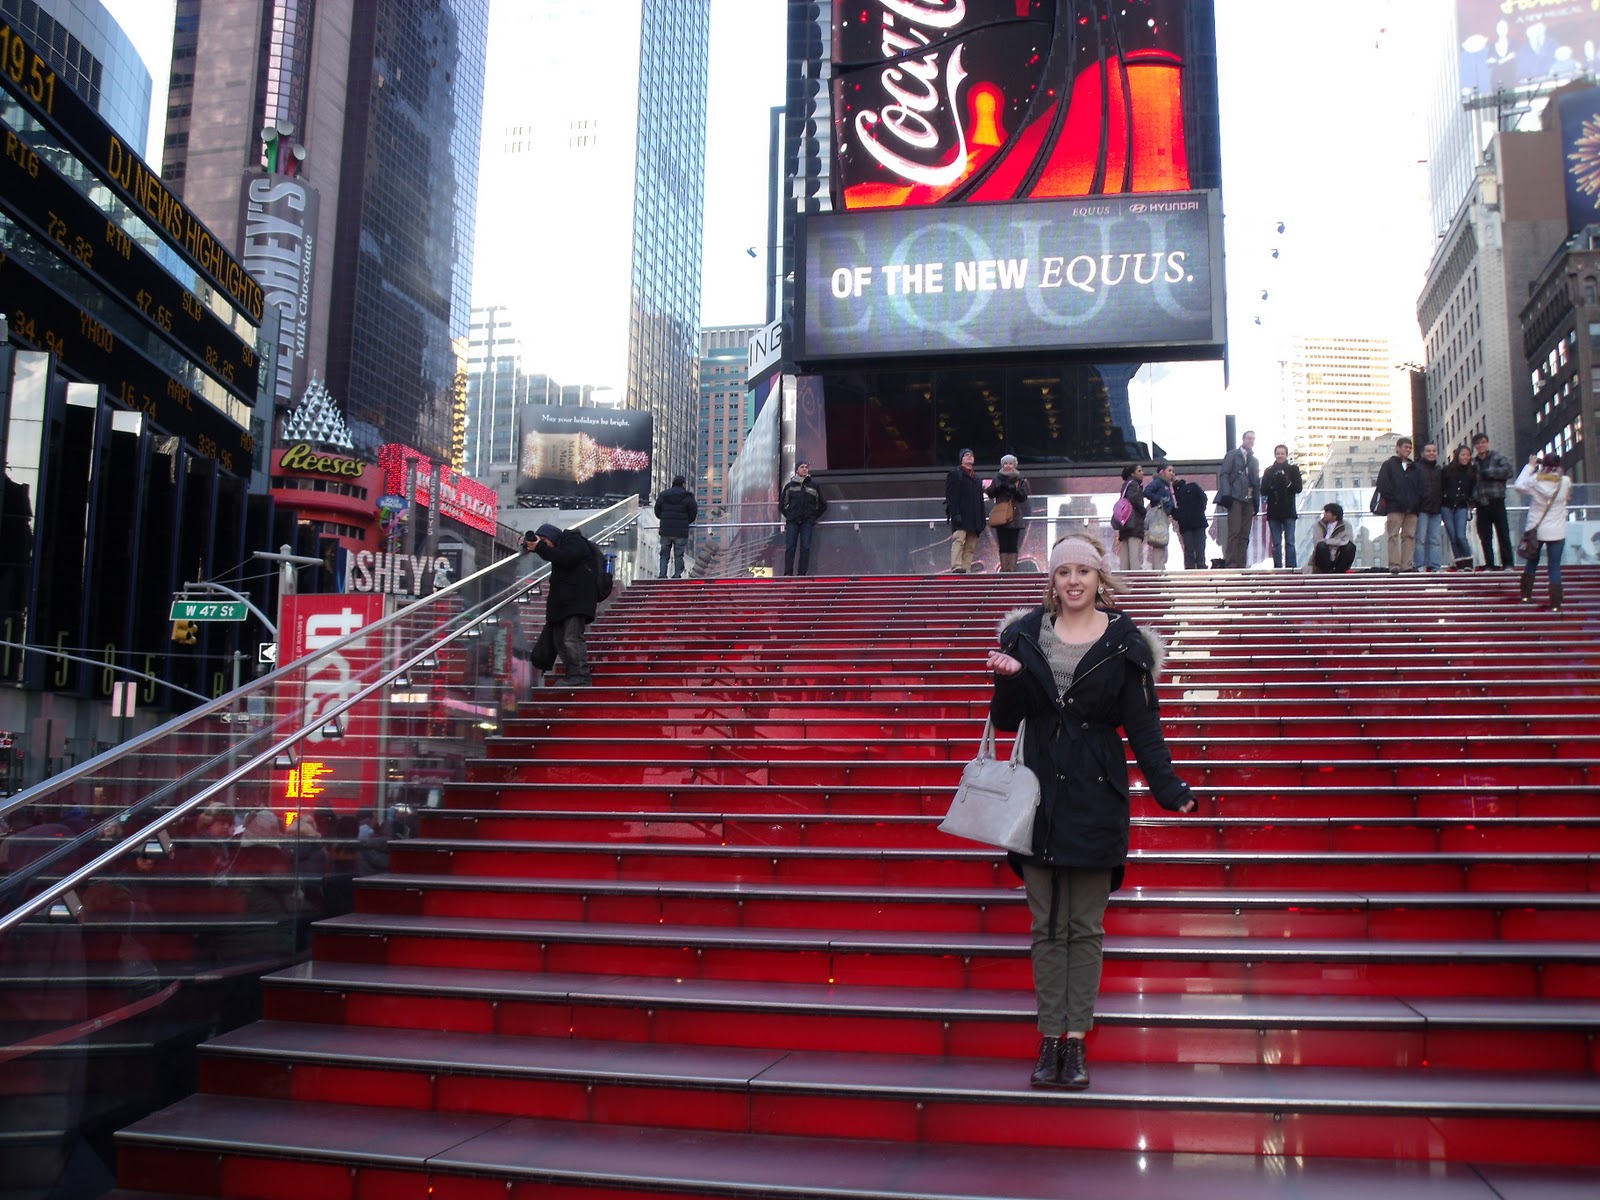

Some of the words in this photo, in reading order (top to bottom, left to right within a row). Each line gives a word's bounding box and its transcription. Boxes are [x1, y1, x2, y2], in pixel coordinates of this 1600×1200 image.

[6, 131, 40, 179] RIG
[106, 220, 132, 261] RTN
[107, 135, 133, 190] DJ
[135, 163, 183, 240] NEWS
[1072, 205, 1111, 218] EQUUS
[1148, 201, 1200, 214] HYUNDAI
[244, 178, 306, 398] SHEY'S
[298, 235, 313, 316] Chocolate
[831, 266, 872, 299] OF
[881, 262, 944, 295] THE
[954, 258, 1029, 293] NEW
[1038, 250, 1196, 293] EQUUS.
[295, 319, 307, 359] Milk
[749, 321, 783, 368] ING
[541, 414, 557, 424] May
[573, 416, 599, 426] holidays
[609, 418, 631, 427] bright.
[280, 443, 367, 478] Reese's
[427, 470, 438, 537] HERSHEYS
[185, 605, 198, 617] W
[199, 605, 218, 617] 47
[220, 605, 234, 617] St
[304, 607, 368, 744] tkts
